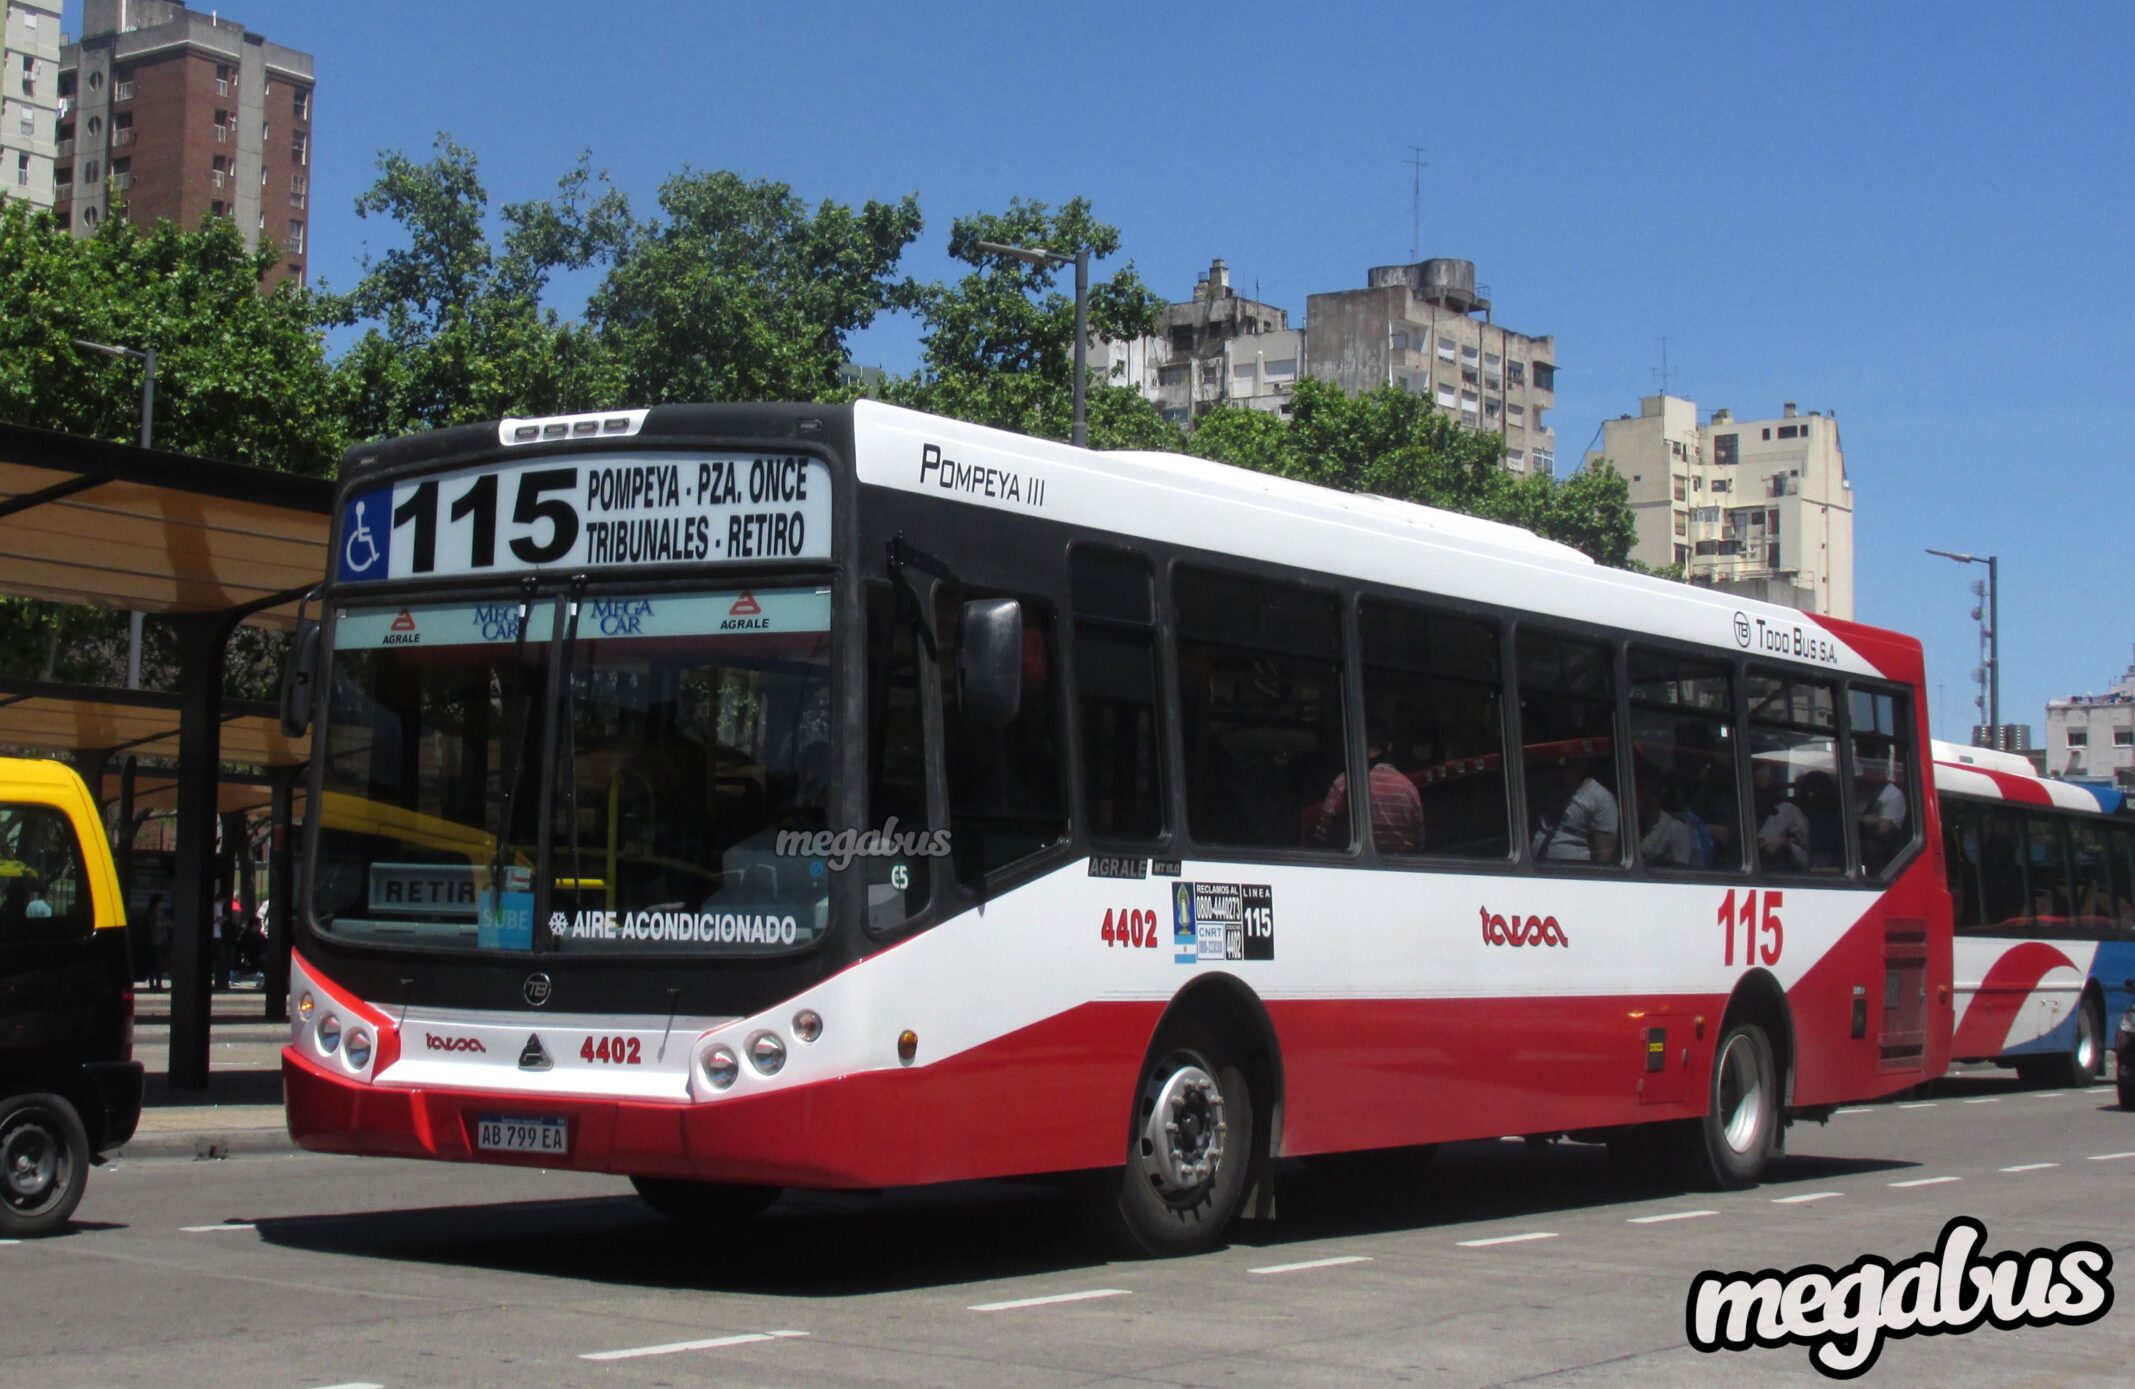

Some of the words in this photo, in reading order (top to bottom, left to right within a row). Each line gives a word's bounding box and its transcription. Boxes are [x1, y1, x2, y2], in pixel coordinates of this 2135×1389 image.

[587, 465, 679, 511] POMPEYA
[698, 462, 741, 505] PZA.
[750, 457, 808, 504] ONCE
[1027, 477, 1045, 506] III
[393, 468, 579, 574] 115
[586, 515, 709, 564] TRIBUNALES
[728, 511, 805, 558] RETIRO
[472, 604, 521, 625] MEG
[591, 598, 655, 619] MEGA
[482, 622, 518, 641] CAR
[599, 616, 643, 635] CAR
[720, 618, 769, 630] AGRALE
[383, 633, 420, 644] AGRALE
[1090, 858, 1147, 877] AGRALE
[385, 880, 490, 904] RETIR
[1196, 884, 1229, 894] RECLAMOS
[1231, 886, 1238, 895] AL
[1243, 888, 1271, 898] LINEA
[572, 911, 617, 938] AIRE
[622, 912, 796, 944] ACONDICIONADO
[1102, 908, 1158, 948] 4402
[1199, 927, 1222, 937] CNRT
[1245, 908, 1272, 937] 115
[1717, 888, 1783, 966] 115
[580, 1036, 641, 1064] 4402
[482, 1124, 501, 1145] AB
[507, 1126, 536, 1147] 799
[542, 1128, 562, 1149] EA
